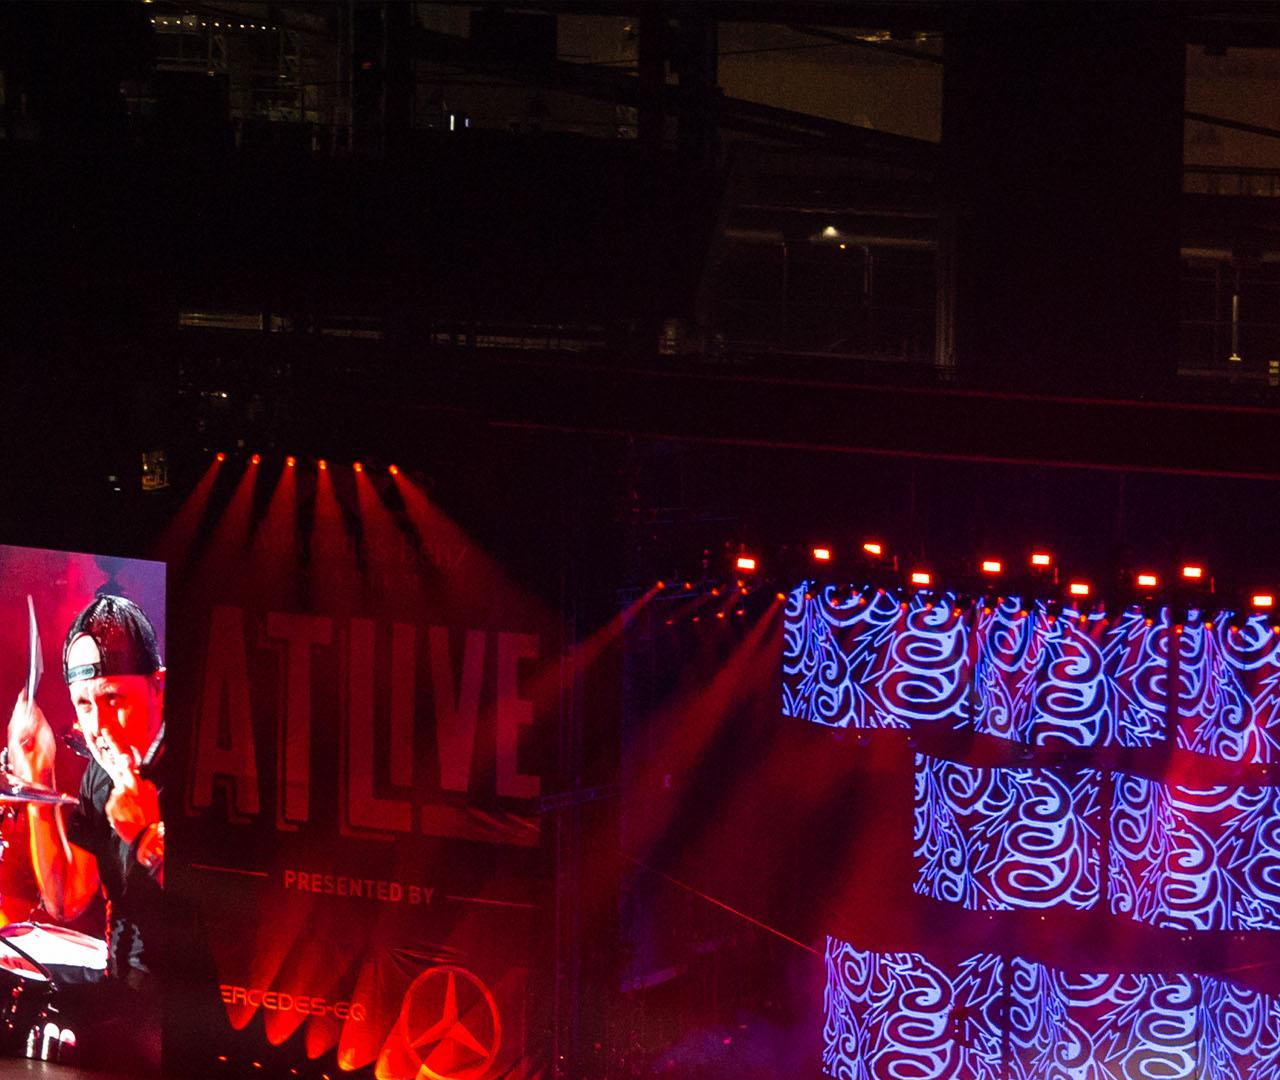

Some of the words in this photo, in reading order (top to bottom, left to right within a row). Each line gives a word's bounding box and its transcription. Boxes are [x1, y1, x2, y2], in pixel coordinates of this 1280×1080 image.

[284, 869, 403, 903] PRESENTED
[409, 886, 434, 905] BY
[219, 985, 367, 1022] ERCEDES-EQ
